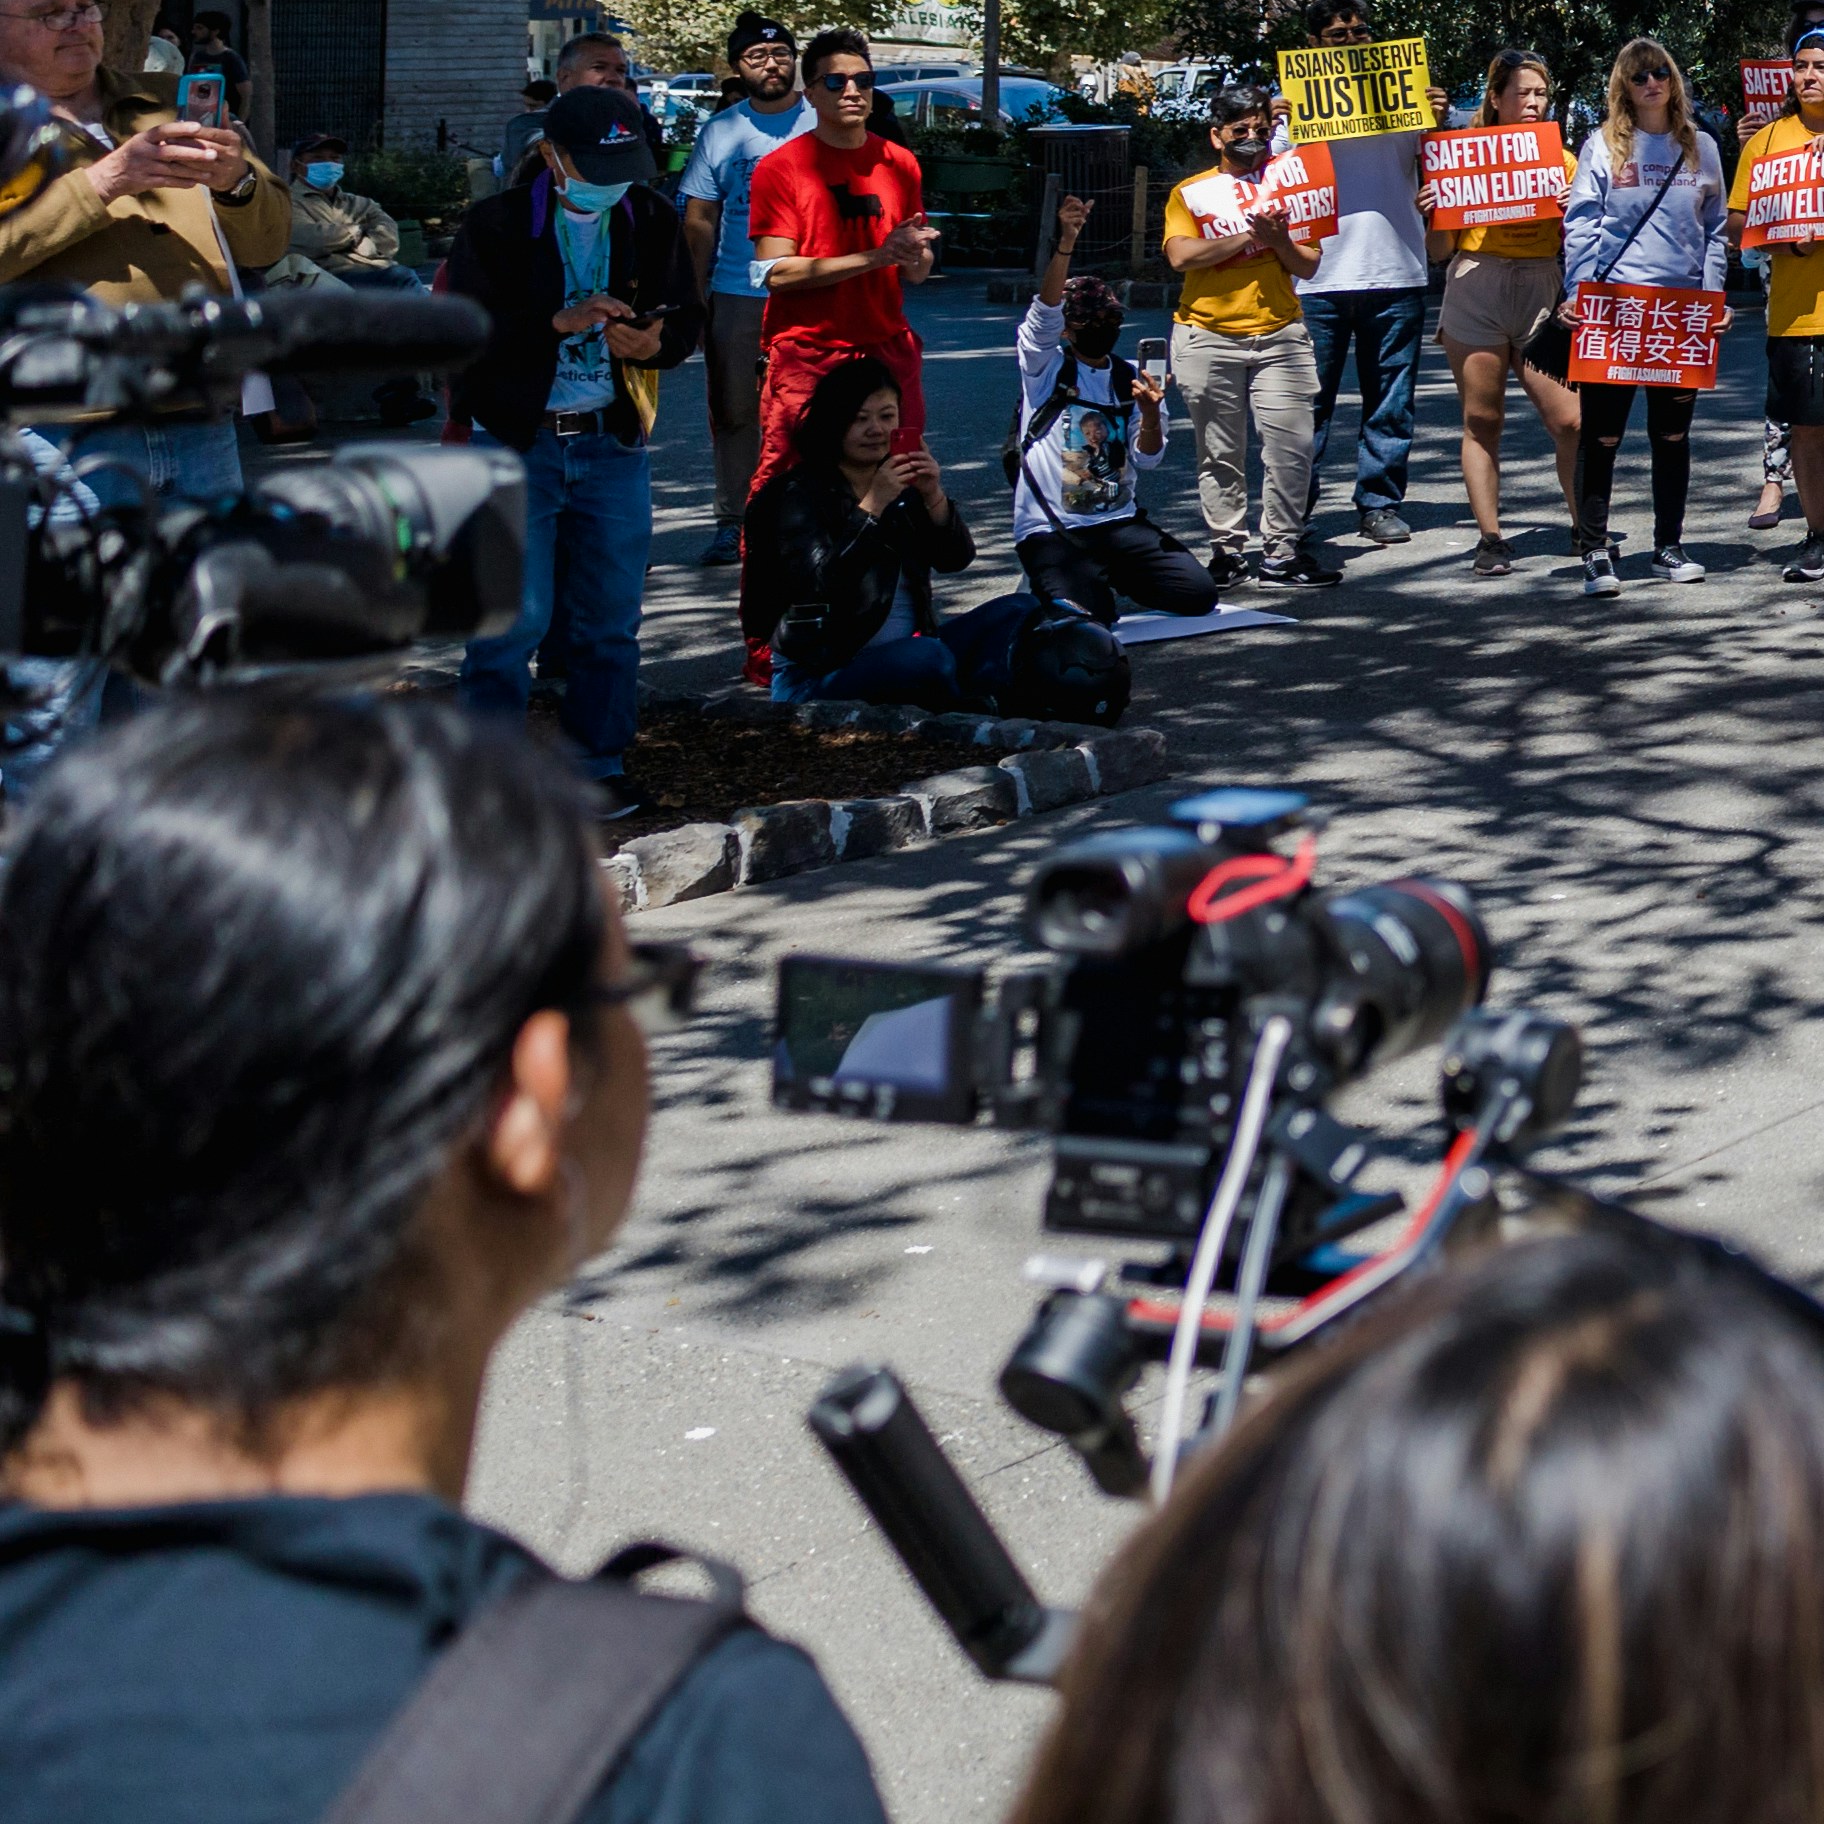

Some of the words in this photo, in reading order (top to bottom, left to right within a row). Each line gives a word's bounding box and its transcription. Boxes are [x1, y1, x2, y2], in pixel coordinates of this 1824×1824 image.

[1285, 49, 1345, 79] ASIANS
[1348, 41, 1424, 74] DESERVE
[1298, 69, 1418, 122] JUSTICE
[1292, 111, 1423, 140] #WEWILLNOTBESILENCED
[1425, 135, 1498, 172] SAFETY
[1501, 131, 1540, 164] FOR
[1430, 174, 1491, 210] ASIAN
[1492, 166, 1567, 204] ELDERS!
[1656, 177, 1697, 187] oaland
[1751, 152, 1807, 193] SAFETY
[1463, 204, 1536, 225] #FIGHTASIANHATE
[1745, 193, 1799, 229] ASIAN
[1582, 294, 1713, 334] 亚裔长者
[1576, 327, 1715, 366] 值得安全!
[1607, 366, 1683, 384] #FIGHTASIANHATE
